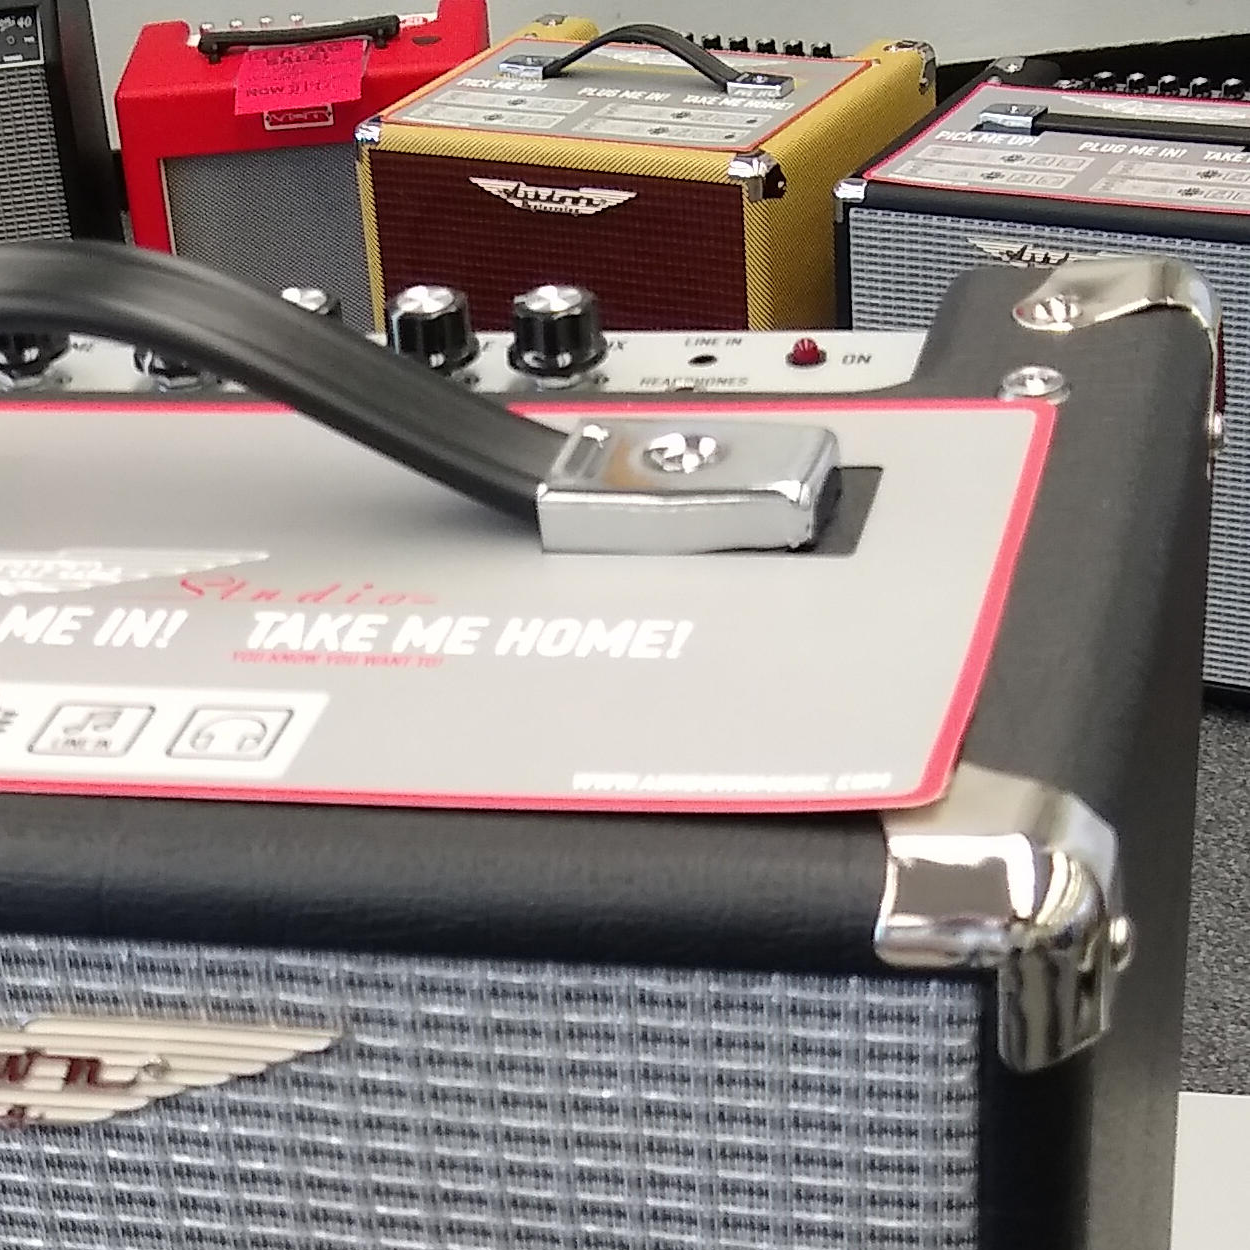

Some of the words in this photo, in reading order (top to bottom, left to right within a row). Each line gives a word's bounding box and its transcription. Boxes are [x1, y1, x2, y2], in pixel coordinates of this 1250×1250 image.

[457, 78, 494, 89] PICK
[493, 81, 518, 90] ME
[577, 87, 621, 99] PLUG
[620, 89, 644, 101] ME
[682, 94, 717, 106] TAKE
[717, 96, 744, 108] ME
[935, 131, 979, 143] PICK
[978, 134, 1005, 145] ME
[1005, 135, 1041, 148] UP!
[1078, 141, 1128, 154] PLUG
[1127, 145, 1160, 157] ME
[1158, 148, 1188, 159] IN!
[1203, 150, 1248, 163] TAKE
[684, 336, 719, 347] LINE
[725, 336, 743, 347] IN
[841, 353, 873, 365] ON
[92, 607, 190, 649] IN!
[246, 611, 390, 653] TAKE
[390, 614, 491, 656] ME
[494, 616, 695, 660] HOME!
